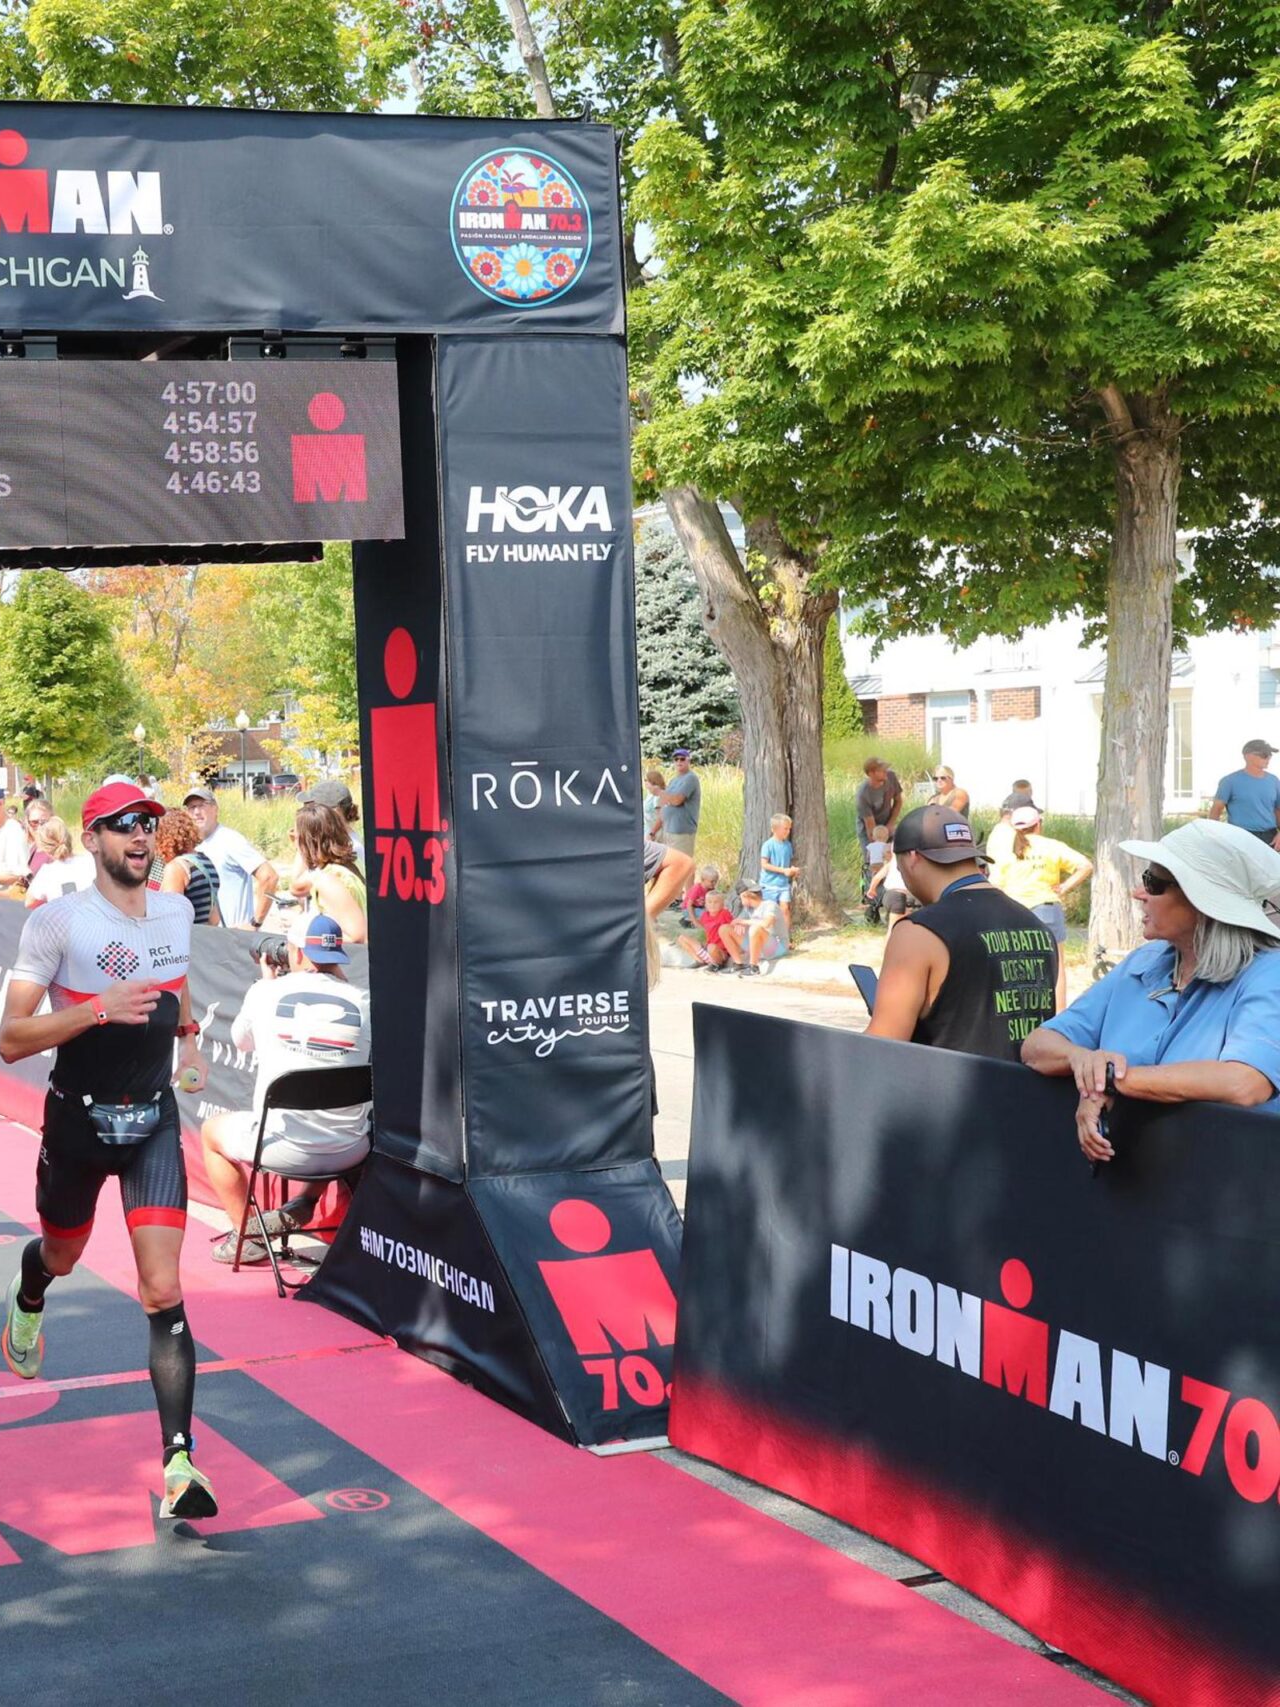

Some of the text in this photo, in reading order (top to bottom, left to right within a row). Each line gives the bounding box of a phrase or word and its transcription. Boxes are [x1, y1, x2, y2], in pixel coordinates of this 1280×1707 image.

[459, 203, 583, 232] IRONMAN 70.3
[161, 381, 257, 404] 4:57:00
[163, 411, 258, 434] 4:54:57
[164, 441, 260, 464] 4:58:56
[166, 470, 261, 494] 4:46:43
[466, 485, 613, 533] HOKA
[466, 542, 613, 563] FLY HUMAN FLY
[375, 834, 447, 905] 70.3
[149, 945, 172, 957] RCT
[981, 931, 1010, 954] YOUR
[480, 990, 630, 1023] TRAVERSE
[995, 989, 1021, 1014] NEE
[1022, 988, 1039, 1010] TO
[577, 1014, 630, 1026] TOURISM
[487, 1022, 572, 1058] city
[359, 1225, 496, 1314] #IM703MICHIGAN
[581, 1355, 673, 1411] 70
[830, 1242, 1280, 1504] IRONMAN 70
